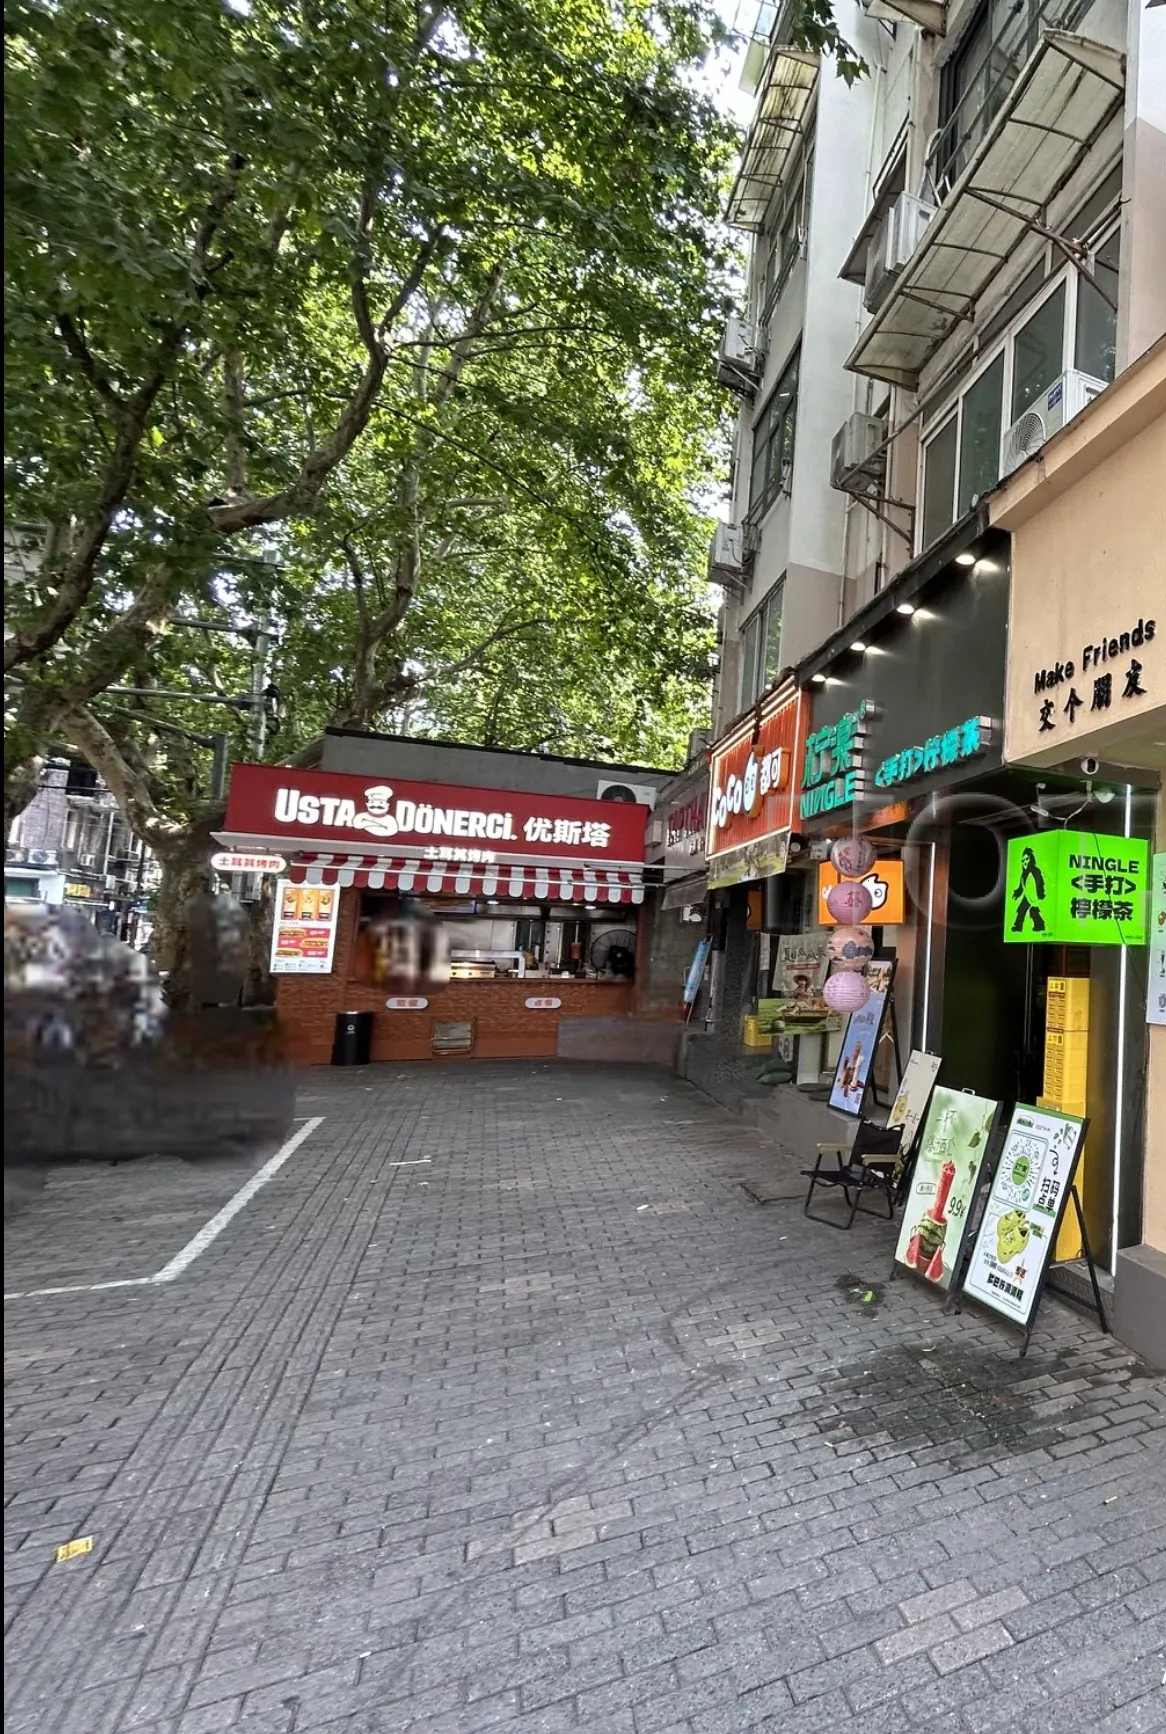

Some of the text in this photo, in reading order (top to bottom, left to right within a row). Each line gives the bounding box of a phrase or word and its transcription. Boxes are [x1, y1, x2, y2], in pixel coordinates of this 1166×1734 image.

[1034, 618, 1157, 694] Make Friends
[1039, 659, 1147, 732] 交个朋友
[274, 788, 355, 828] USTA
[523, 816, 611, 848] 优斯塔
[712, 773, 742, 828] CoCo
[1069, 854, 1139, 874] NINGLE
